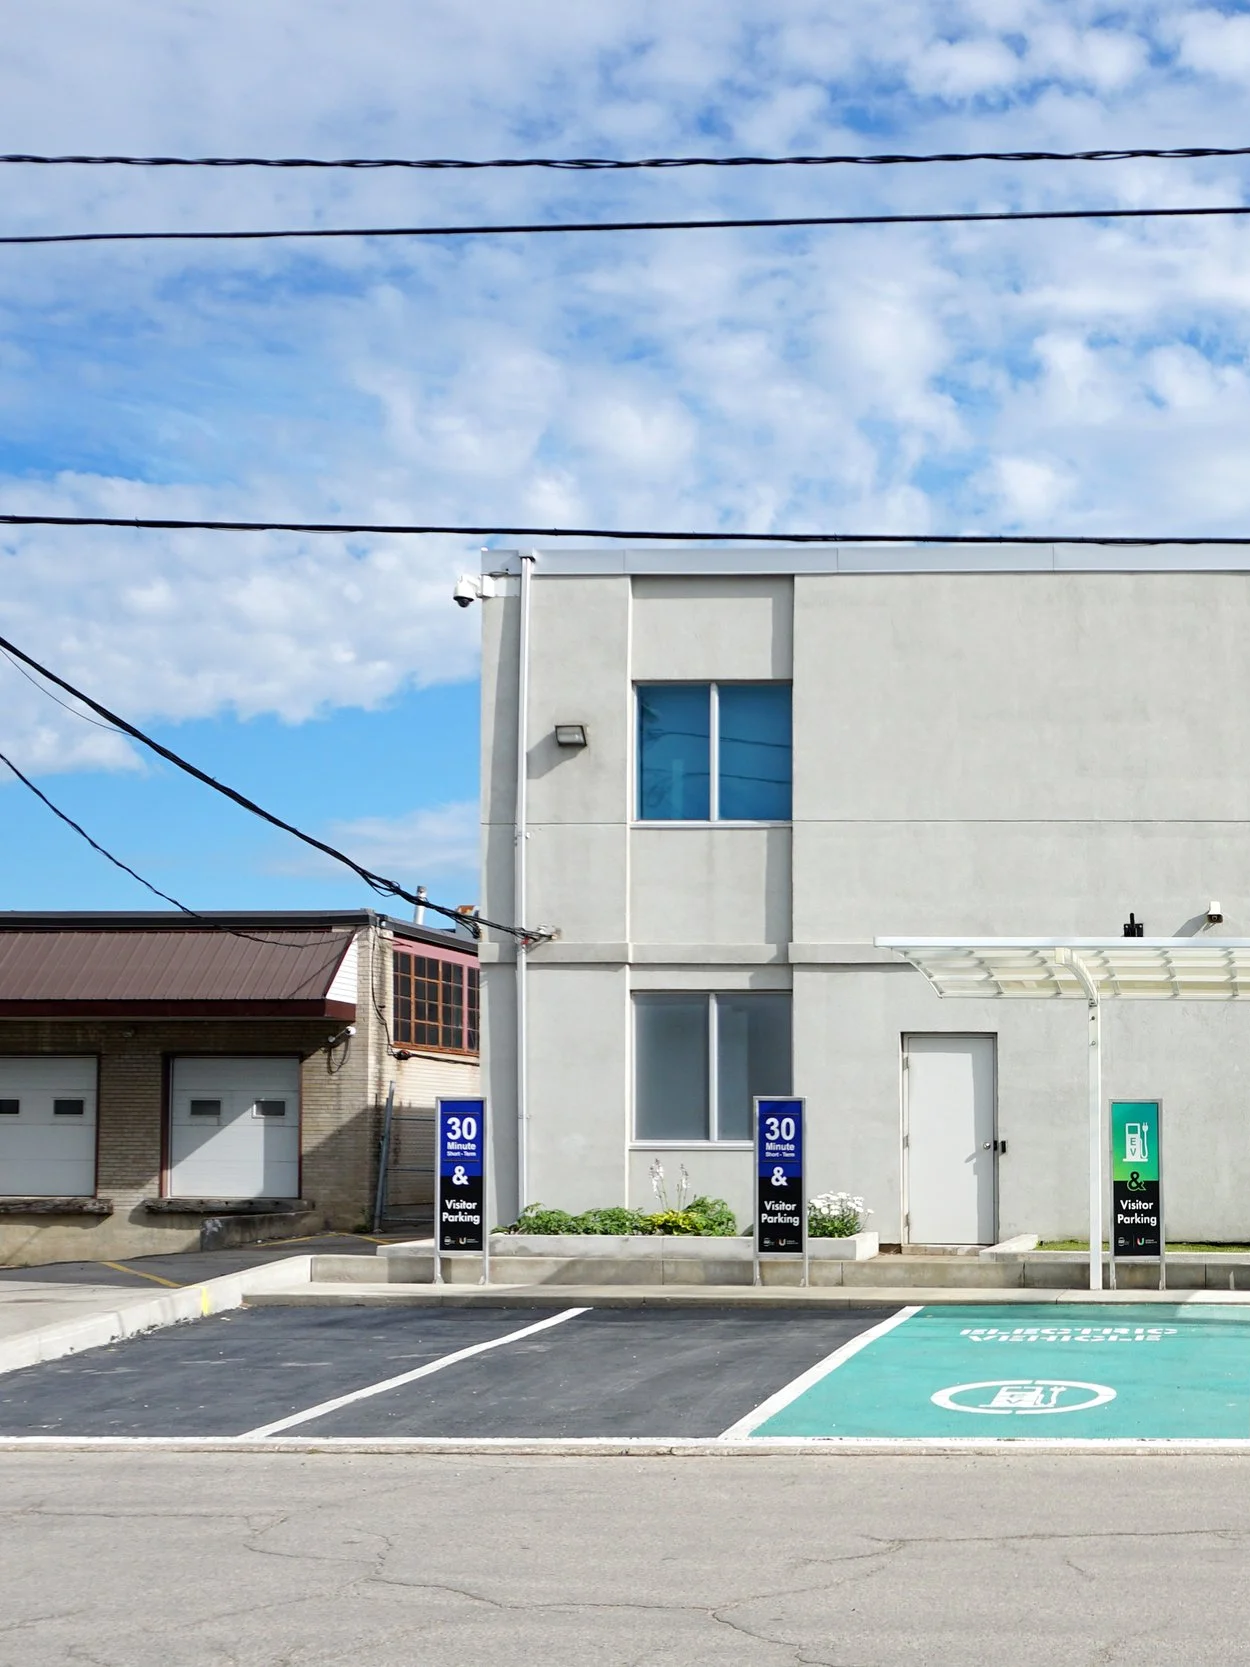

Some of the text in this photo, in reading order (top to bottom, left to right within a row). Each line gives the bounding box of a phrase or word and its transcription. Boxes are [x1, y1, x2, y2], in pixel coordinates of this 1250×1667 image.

[446, 1117, 477, 1140] 30
[765, 1117, 795, 1141] 30
[446, 1142, 476, 1150] Minute
[765, 1143, 795, 1151] Minute
[452, 1165, 469, 1185] &
[770, 1166, 788, 1186] &
[1127, 1171, 1146, 1191] &
[445, 1199, 477, 1210] Visitor
[764, 1201, 796, 1211] Visitor
[1120, 1200, 1154, 1210] Visitor
[442, 1212, 480, 1225] Parking
[761, 1213, 800, 1226] Parking
[1118, 1213, 1157, 1226] Parking
